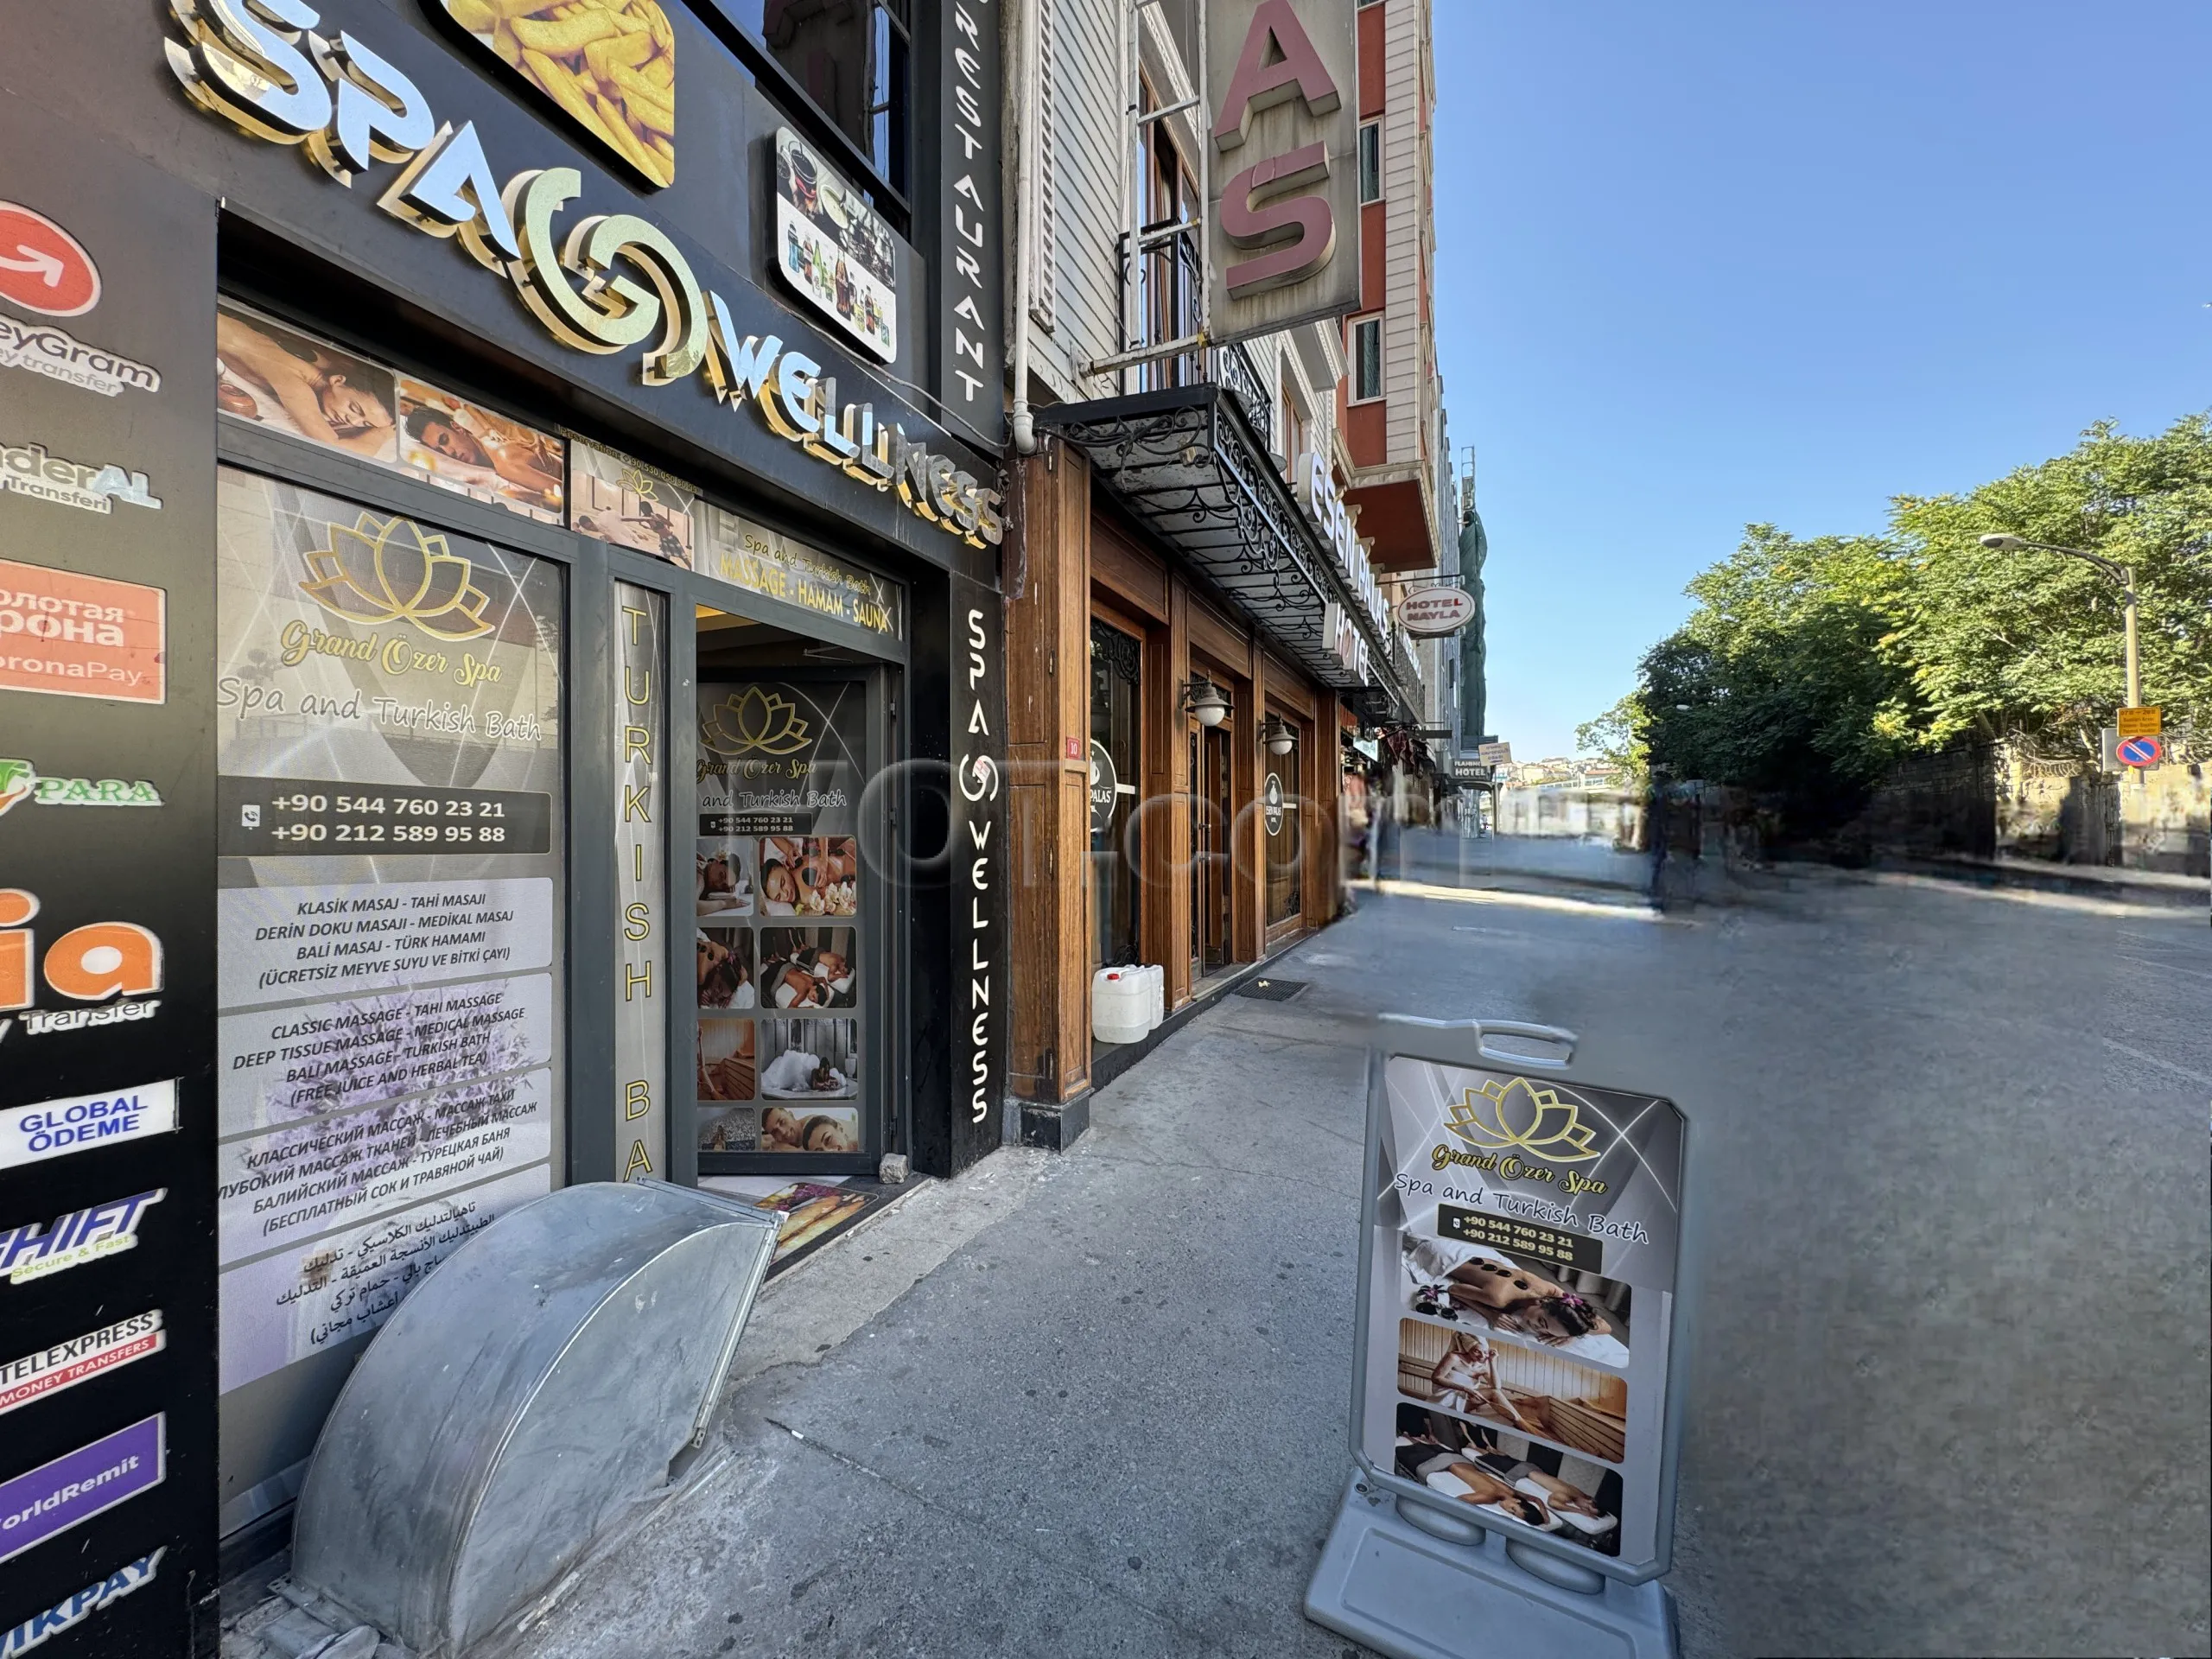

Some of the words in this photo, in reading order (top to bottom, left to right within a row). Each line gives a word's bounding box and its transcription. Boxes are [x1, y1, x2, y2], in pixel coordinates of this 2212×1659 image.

[22, 354, 118, 392] transfer
[708, 291, 1002, 547] WELLNESS
[745, 534, 770, 556] Spa
[774, 550, 798, 567] and
[802, 556, 842, 585] Turkish
[845, 574, 871, 596] Bath
[1310, 453, 1356, 579] ESEN
[1357, 543, 1389, 640] PALAS
[721, 552, 786, 597] MASSAGE
[798, 579, 843, 618] HAMAM
[853, 598, 888, 634] SAUNA
[1406, 598, 1463, 610] HOTEL
[1407, 610, 1460, 621] NAYLA
[281, 619, 378, 666] Grand
[381, 632, 448, 676] Özer
[454, 652, 504, 689] Spa
[1335, 602, 1369, 687] HOTEL
[968, 608, 990, 738] SPA
[217, 677, 284, 719] Spa
[300, 690, 361, 721] and
[373, 696, 476, 734] Turkish
[485, 711, 542, 741] Bath
[785, 758, 818, 779] Spa
[1071, 743, 1077, 755] 10
[40, 779, 157, 802] PARA
[271, 794, 327, 812] +90
[336, 797, 386, 814] 544
[393, 798, 438, 817] 760
[445, 801, 473, 817] 23
[480, 802, 505, 818] 21
[622, 605, 652, 1002] TURKISH
[702, 789, 734, 808] and
[740, 789, 800, 808] Turkish
[806, 789, 847, 808] Bath
[271, 824, 327, 842] +90
[335, 824, 385, 842] 212
[393, 825, 438, 842] 589
[445, 826, 473, 842] 95
[479, 827, 505, 842] 88
[255, 921, 304, 942] DERİN
[308, 920, 353, 938] DOKU
[356, 918, 407, 934] MASAJI
[417, 913, 474, 929] MEDİKAL
[475, 910, 513, 923] MASAJ
[297, 899, 348, 915] KLASİK
[352, 896, 399, 912] MASAJ
[442, 893, 486, 907] MASAJI
[258, 965, 337, 989] (ÜCRETSİZ
[340, 960, 391, 978] MEYVE
[392, 957, 429, 971] SUYU
[431, 952, 448, 967] VE
[450, 947, 480, 965] BİTKİ
[482, 947, 511, 963] ÇAYI)
[296, 942, 330, 961] BALİ
[334, 940, 383, 957] MASAJ
[394, 934, 429, 950] TÜRK
[431, 931, 486, 947] HAMAMI
[969, 820, 992, 1124] WELLNESS
[21, 1000, 160, 1033] Transfer
[233, 1050, 276, 1070] DEEP
[281, 1041, 334, 1063] TISSUE
[336, 1029, 403, 1052] MASSAGE
[413, 1018, 469, 1038] MEDICAL
[472, 1007, 524, 1026] MASSAGE
[270, 1020, 333, 1040] CLASSIC
[336, 1008, 403, 1027] MASSAGE
[446, 993, 502, 1013] MASSAGE
[286, 1065, 322, 1083] BALI
[324, 1051, 393, 1075] MASSAGE
[404, 1038, 458, 1059] TURKISH
[460, 1032, 491, 1047] BATH
[290, 1085, 332, 1107] (FREE
[335, 1075, 374, 1095] JUICE
[377, 1069, 408, 1089] AND
[410, 1059, 461, 1079] HERBAL
[461, 1051, 487, 1071] TEA)
[20, 1095, 149, 1134] GLOBAL
[28, 1113, 140, 1153] ÖDEME
[247, 1128, 365, 1169] КЛАССИЧЕСКИЙ
[368, 1113, 424, 1137] МАССАЖ
[434, 1099, 486, 1119] МАССАЖ
[487, 1090, 515, 1104] ТАХИ
[298, 1151, 362, 1179] МАССАЖ
[366, 1133, 417, 1159] ТКАНЕЙ
[426, 1112, 489, 1142] ЛЕЧЕБНЫЙ
[491, 1101, 537, 1122] МАССАЖ
[253, 1174, 347, 1213] БАЛИЙСКИЙ
[351, 1158, 410, 1185] МАССАЖ
[420, 1136, 480, 1166] ТУРЕЦКАЯ
[481, 1127, 511, 1146] БАНЯ
[262, 1189, 368, 1236] (БЕСПЛАТНЫЙ
[371, 1181, 397, 1199] СОК
[399, 1178, 410, 1190] И
[413, 1160, 474, 1189] ТРАВЯНОЙ
[477, 1147, 505, 1167] ЧАЙ)
[1431, 1143, 1498, 1171] Grand
[1499, 1153, 1555, 1184] Özer
[1558, 1169, 1609, 1196] Spa
[1394, 1173, 1434, 1195] Spa
[1441, 1185, 1484, 1206] and
[1493, 1192, 1579, 1228] Turkish
[1587, 1213, 1649, 1244] Bath
[1463, 1215, 1487, 1230] +90
[1488, 1217, 1511, 1234] 544
[1513, 1223, 1536, 1239] 760
[1538, 1230, 1555, 1243] 23
[1557, 1235, 1573, 1249] 21
[12, 1254, 73, 1278] Secure
[78, 1247, 90, 1257] &
[95, 1236, 130, 1252] Fast
[1463, 1227, 1486, 1243] +90
[1487, 1232, 1511, 1247] 212
[1512, 1236, 1536, 1252] 589
[1537, 1243, 1554, 1257] 95
[1556, 1247, 1573, 1262] 88
[0, 1313, 153, 1383] TELEXPRESS
[0, 1371, 63, 1407] MONEY
[68, 1338, 149, 1377] TRANSFERS
[0, 1455, 139, 1529] orldRemit
